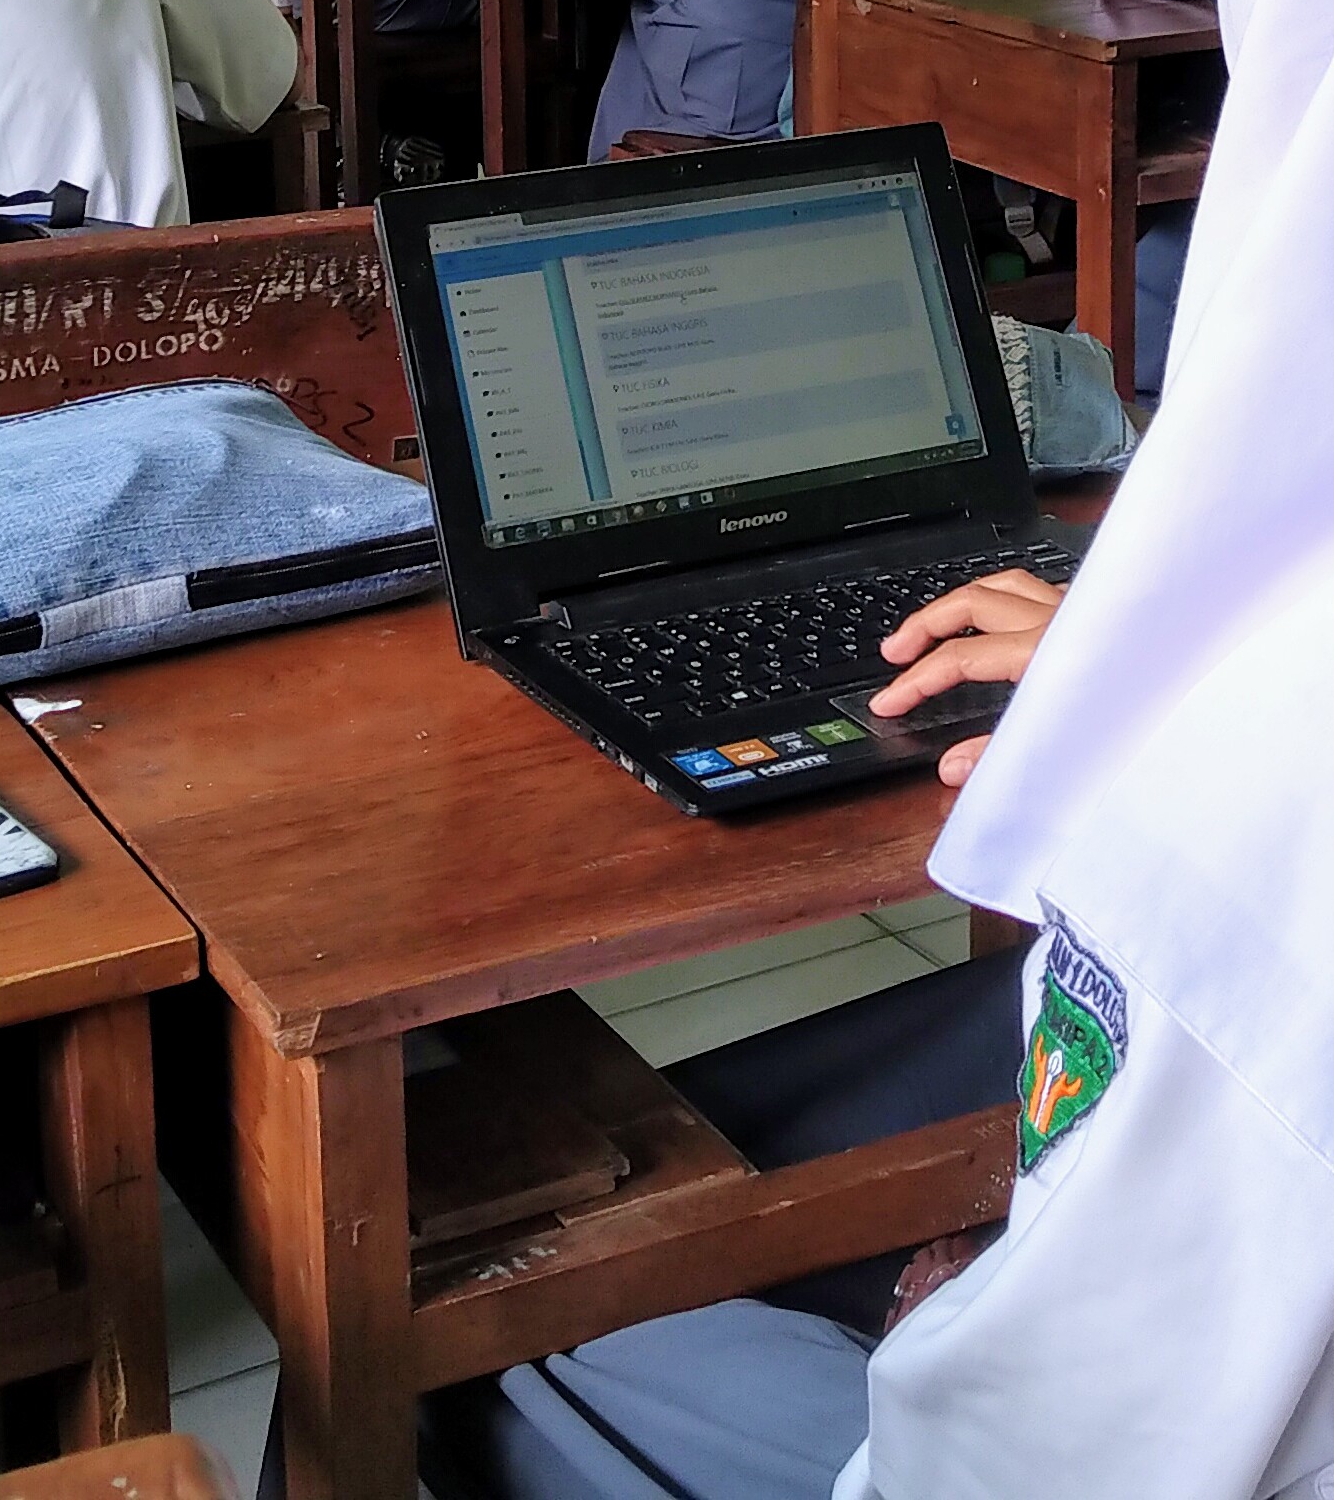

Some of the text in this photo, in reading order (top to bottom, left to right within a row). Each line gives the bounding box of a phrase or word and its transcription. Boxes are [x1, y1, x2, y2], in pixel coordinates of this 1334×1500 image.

[621, 274, 659, 287] BAHASA
[93, 328, 224, 368] DOLOPO
[720, 510, 788, 534] lenovo
